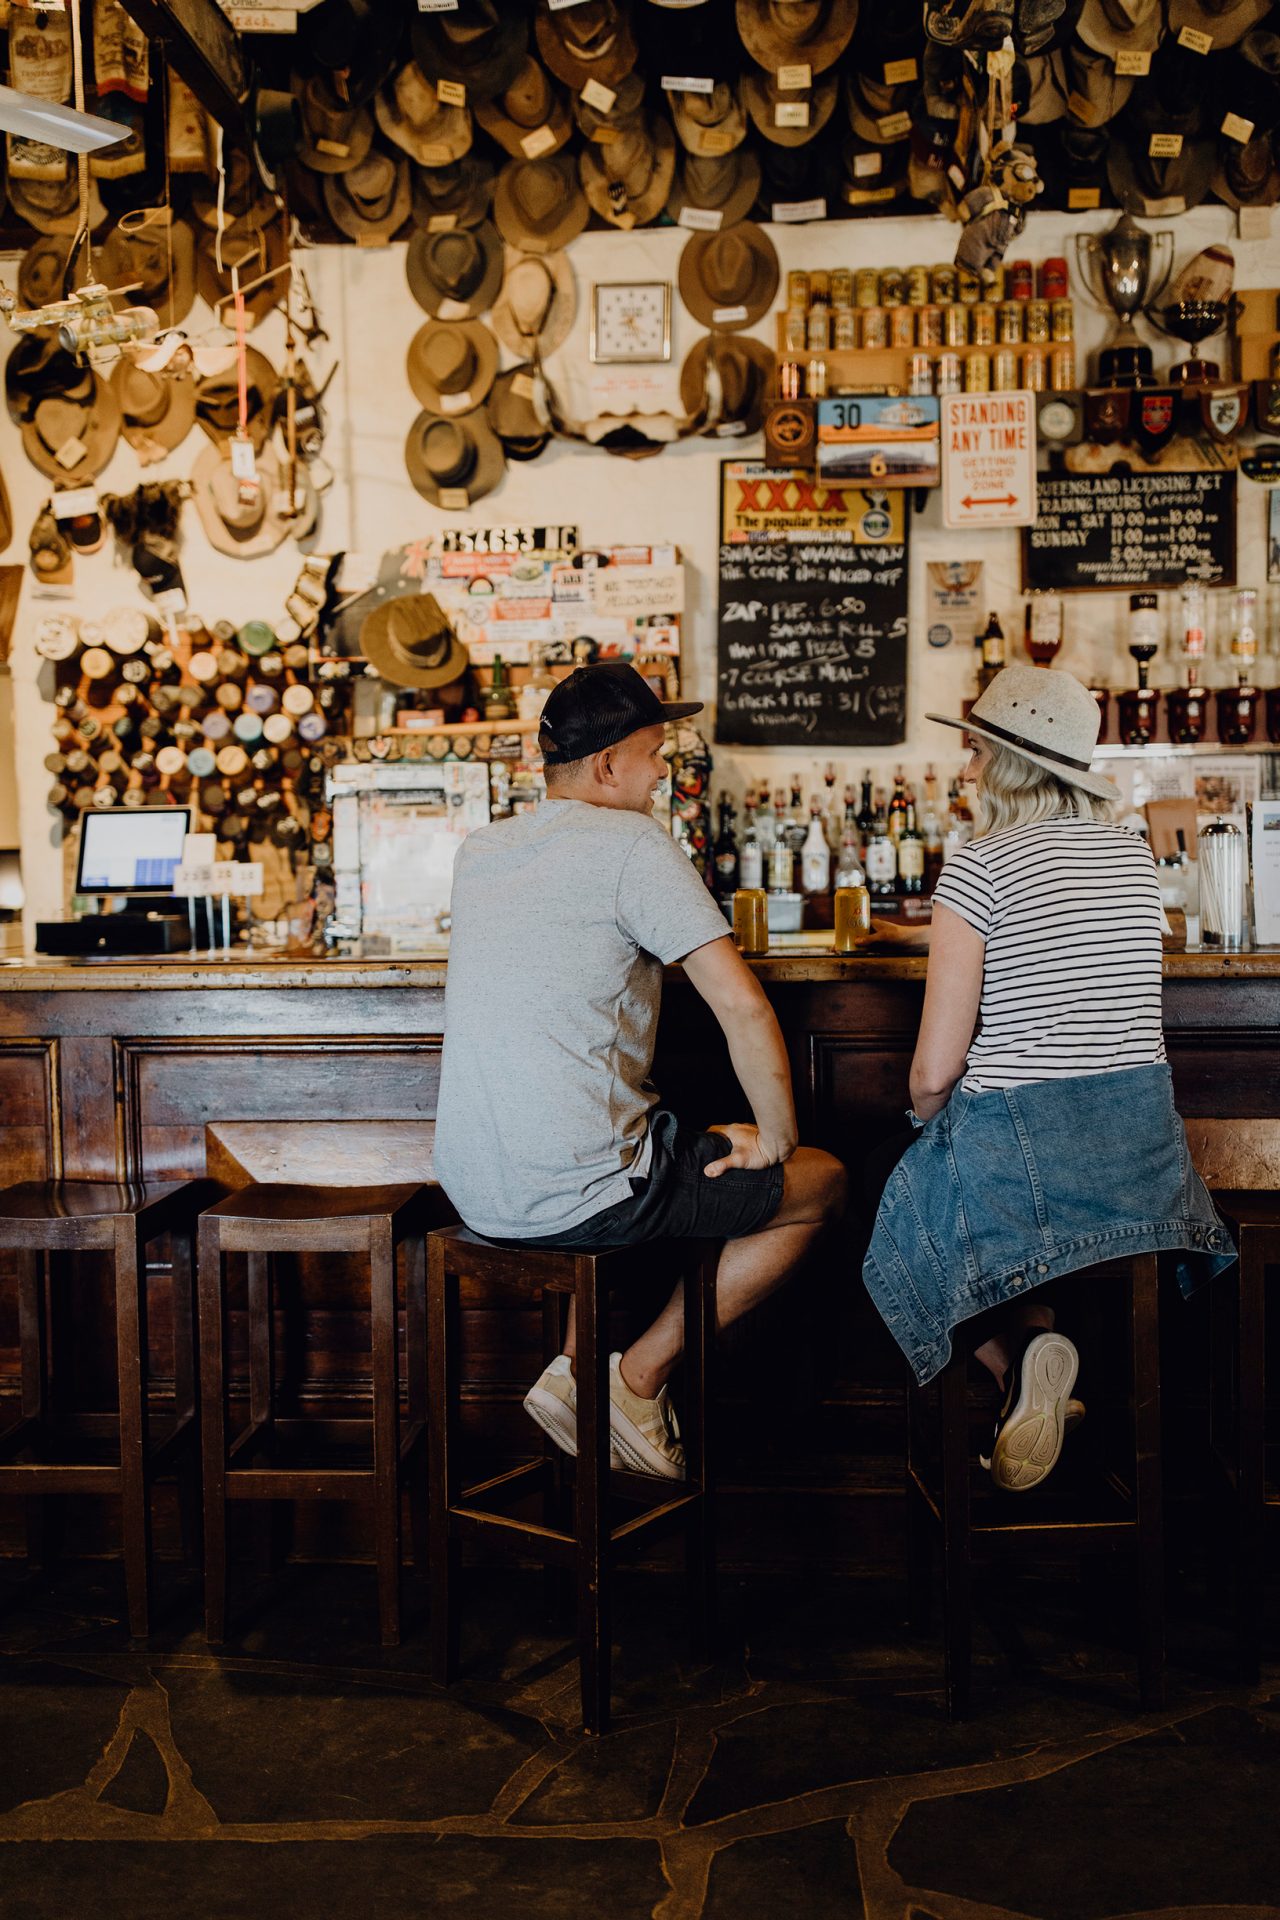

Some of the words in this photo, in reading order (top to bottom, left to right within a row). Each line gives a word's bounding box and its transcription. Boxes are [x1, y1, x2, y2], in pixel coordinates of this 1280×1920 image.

[833, 404, 862, 430] 30
[951, 401, 1025, 426] STANDING
[952, 430, 980, 452] ANY
[990, 428, 1025, 450] TIME
[870, 452, 887, 477] 6
[962, 456, 1017, 467] GETTING
[1123, 476, 1192, 493] LICENSING
[1195, 474, 1222, 490] ACT
[736, 479, 849, 512] XXXX
[1096, 495, 1142, 511] HOURS
[736, 514, 760, 527] The
[764, 515, 811, 531] popular
[818, 514, 848, 527] beer
[1081, 513, 1106, 528] SAT
[1031, 529, 1089, 548] SUNDAY
[749, 565, 790, 583] COOK
[873, 567, 903, 587] OFF
